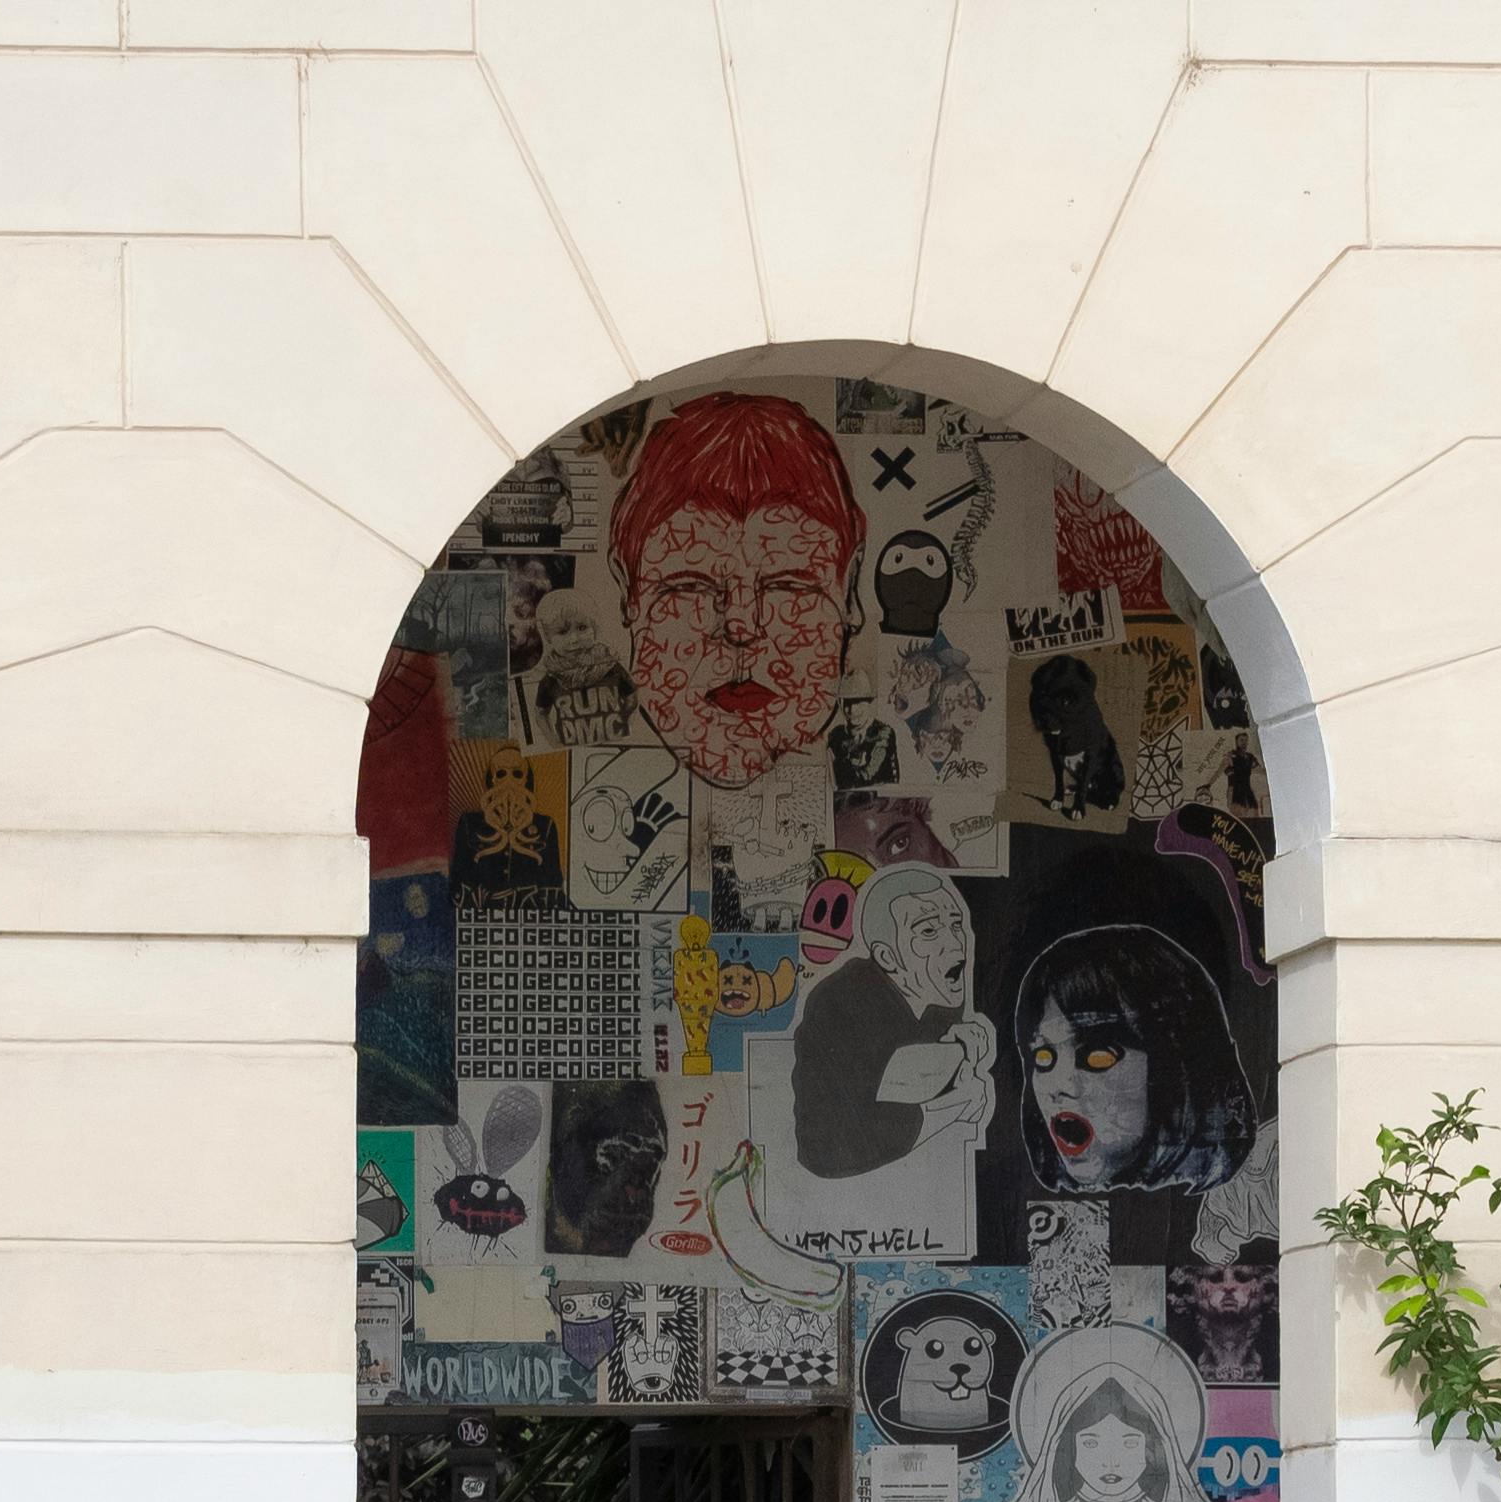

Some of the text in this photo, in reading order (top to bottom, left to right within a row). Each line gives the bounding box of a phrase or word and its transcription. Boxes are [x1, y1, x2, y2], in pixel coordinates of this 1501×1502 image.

[1014, 627, 1104, 652] ON THE RUN
[556, 686, 621, 718] RUN
[563, 712, 630, 746] DMC
[1211, 814, 1236, 834] YOU
[674, 1091, 715, 1225] ゴリラ
